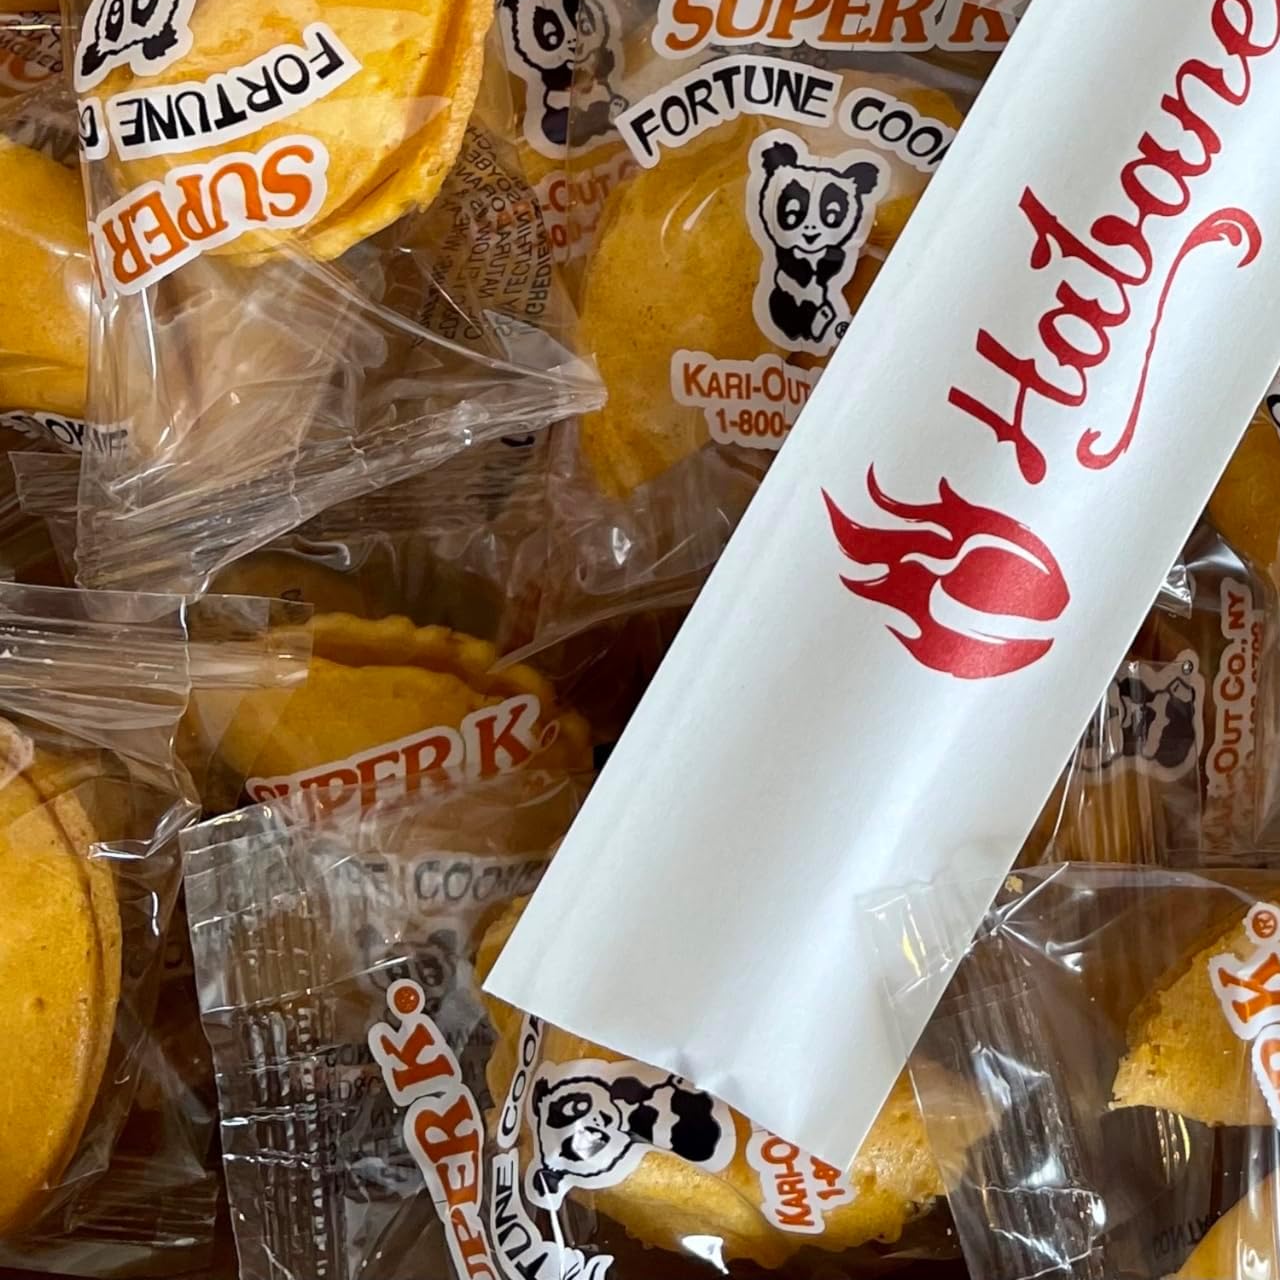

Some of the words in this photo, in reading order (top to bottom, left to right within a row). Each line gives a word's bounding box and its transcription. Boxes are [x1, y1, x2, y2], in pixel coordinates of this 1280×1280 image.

[120, 33, 345, 147] FORTUNE
[632, 66, 834, 158] FORTUNE
[103, 144, 315, 286] SUPER
[683, 363, 812, 405] KARI-OUT
[1227, 591, 1246, 630] NY
[380, 1023, 454, 1092] K
